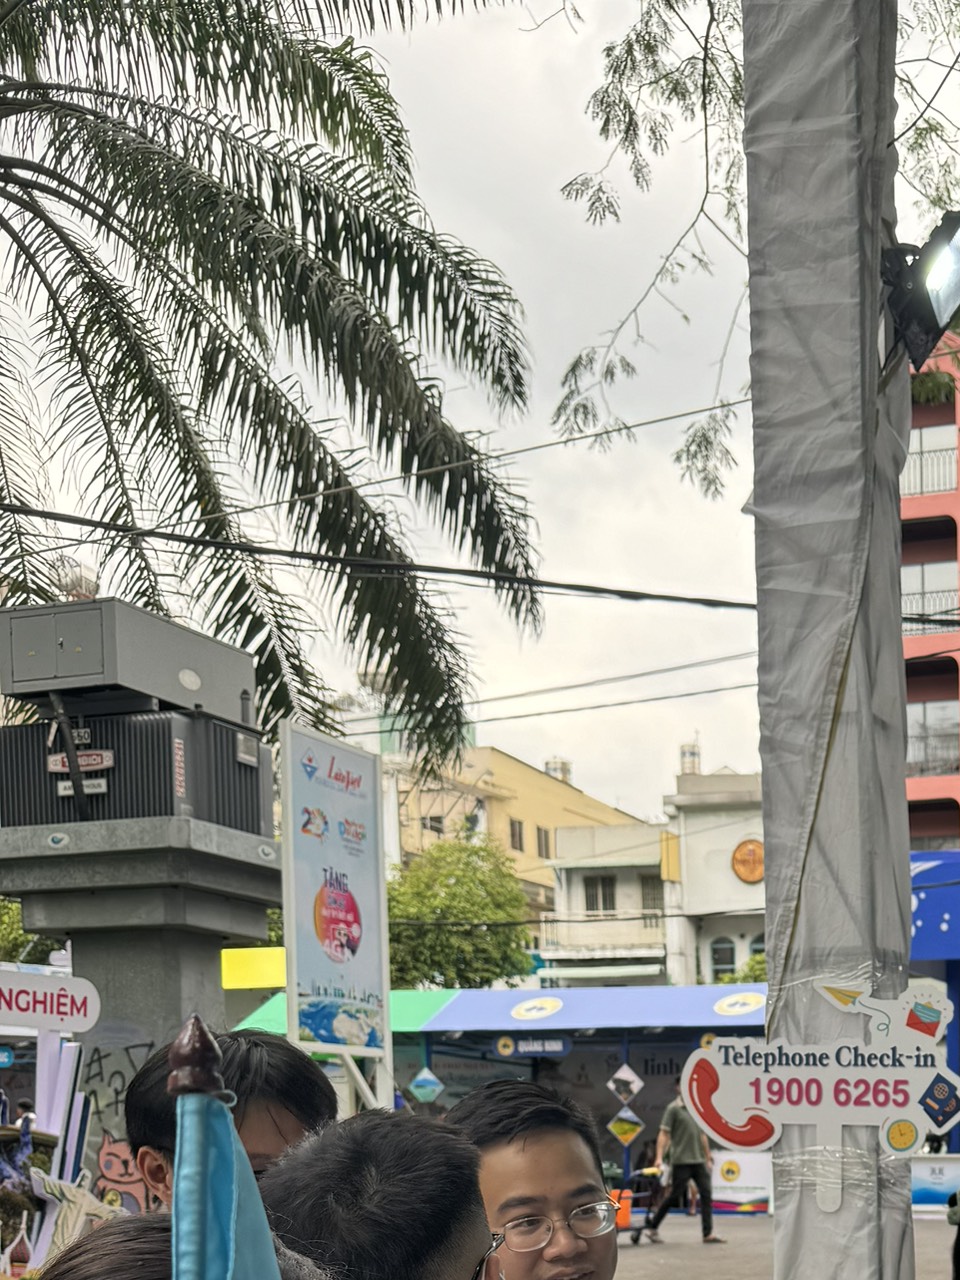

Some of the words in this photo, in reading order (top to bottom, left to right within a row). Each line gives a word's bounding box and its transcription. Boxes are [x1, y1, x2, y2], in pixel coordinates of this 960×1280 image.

[718, 1045, 829, 1073] Telephone
[835, 1045, 936, 1068] Check-in
[749, 1077, 823, 1107] 1900
[833, 1078, 910, 1108] 6265
